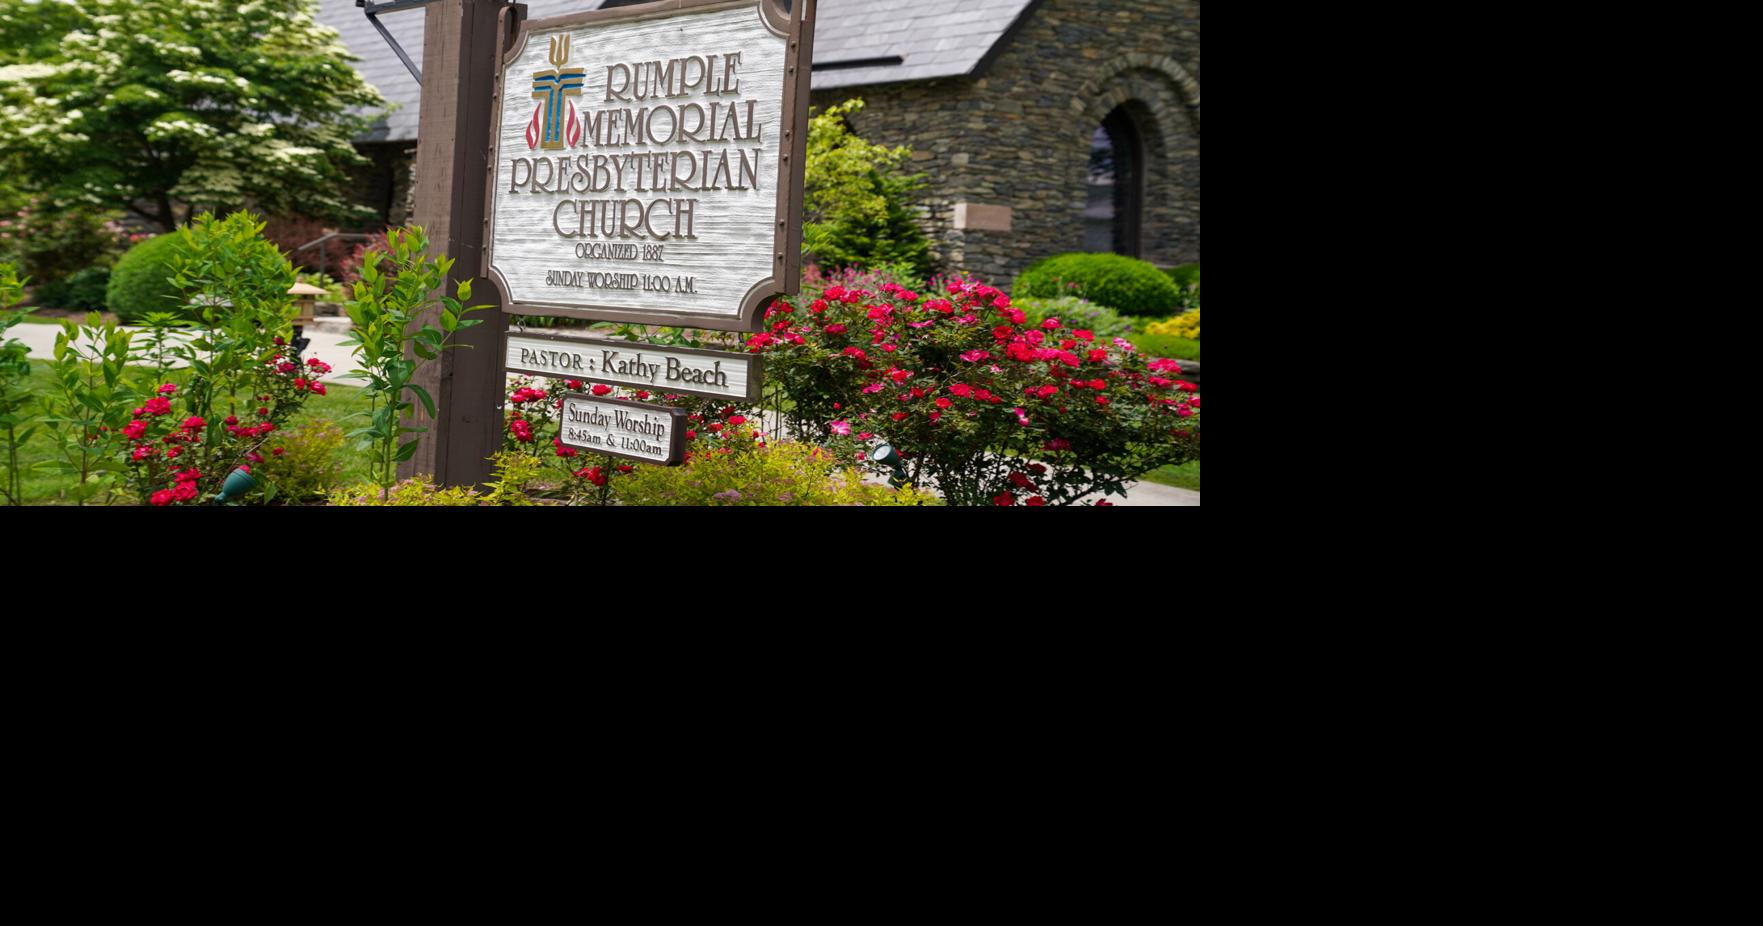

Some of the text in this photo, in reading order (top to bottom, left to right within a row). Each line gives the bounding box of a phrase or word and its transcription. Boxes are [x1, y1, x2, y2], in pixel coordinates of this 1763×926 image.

[604, 51, 742, 104] RUMPLE
[580, 99, 763, 148] MEMORIAL
[508, 148, 761, 195] PRESBYTERIAN
[552, 198, 699, 240] CHURCH
[575, 242, 638, 261] ORGANIZED
[545, 269, 698, 294] SUNDAY WORSHIP 11:00 A.M.
[520, 347, 729, 389] PASTOR : Kathy Beach
[568, 402, 666, 442] Sunday Worship
[568, 427, 602, 445] 8:45am
[606, 433, 617, 447] &
